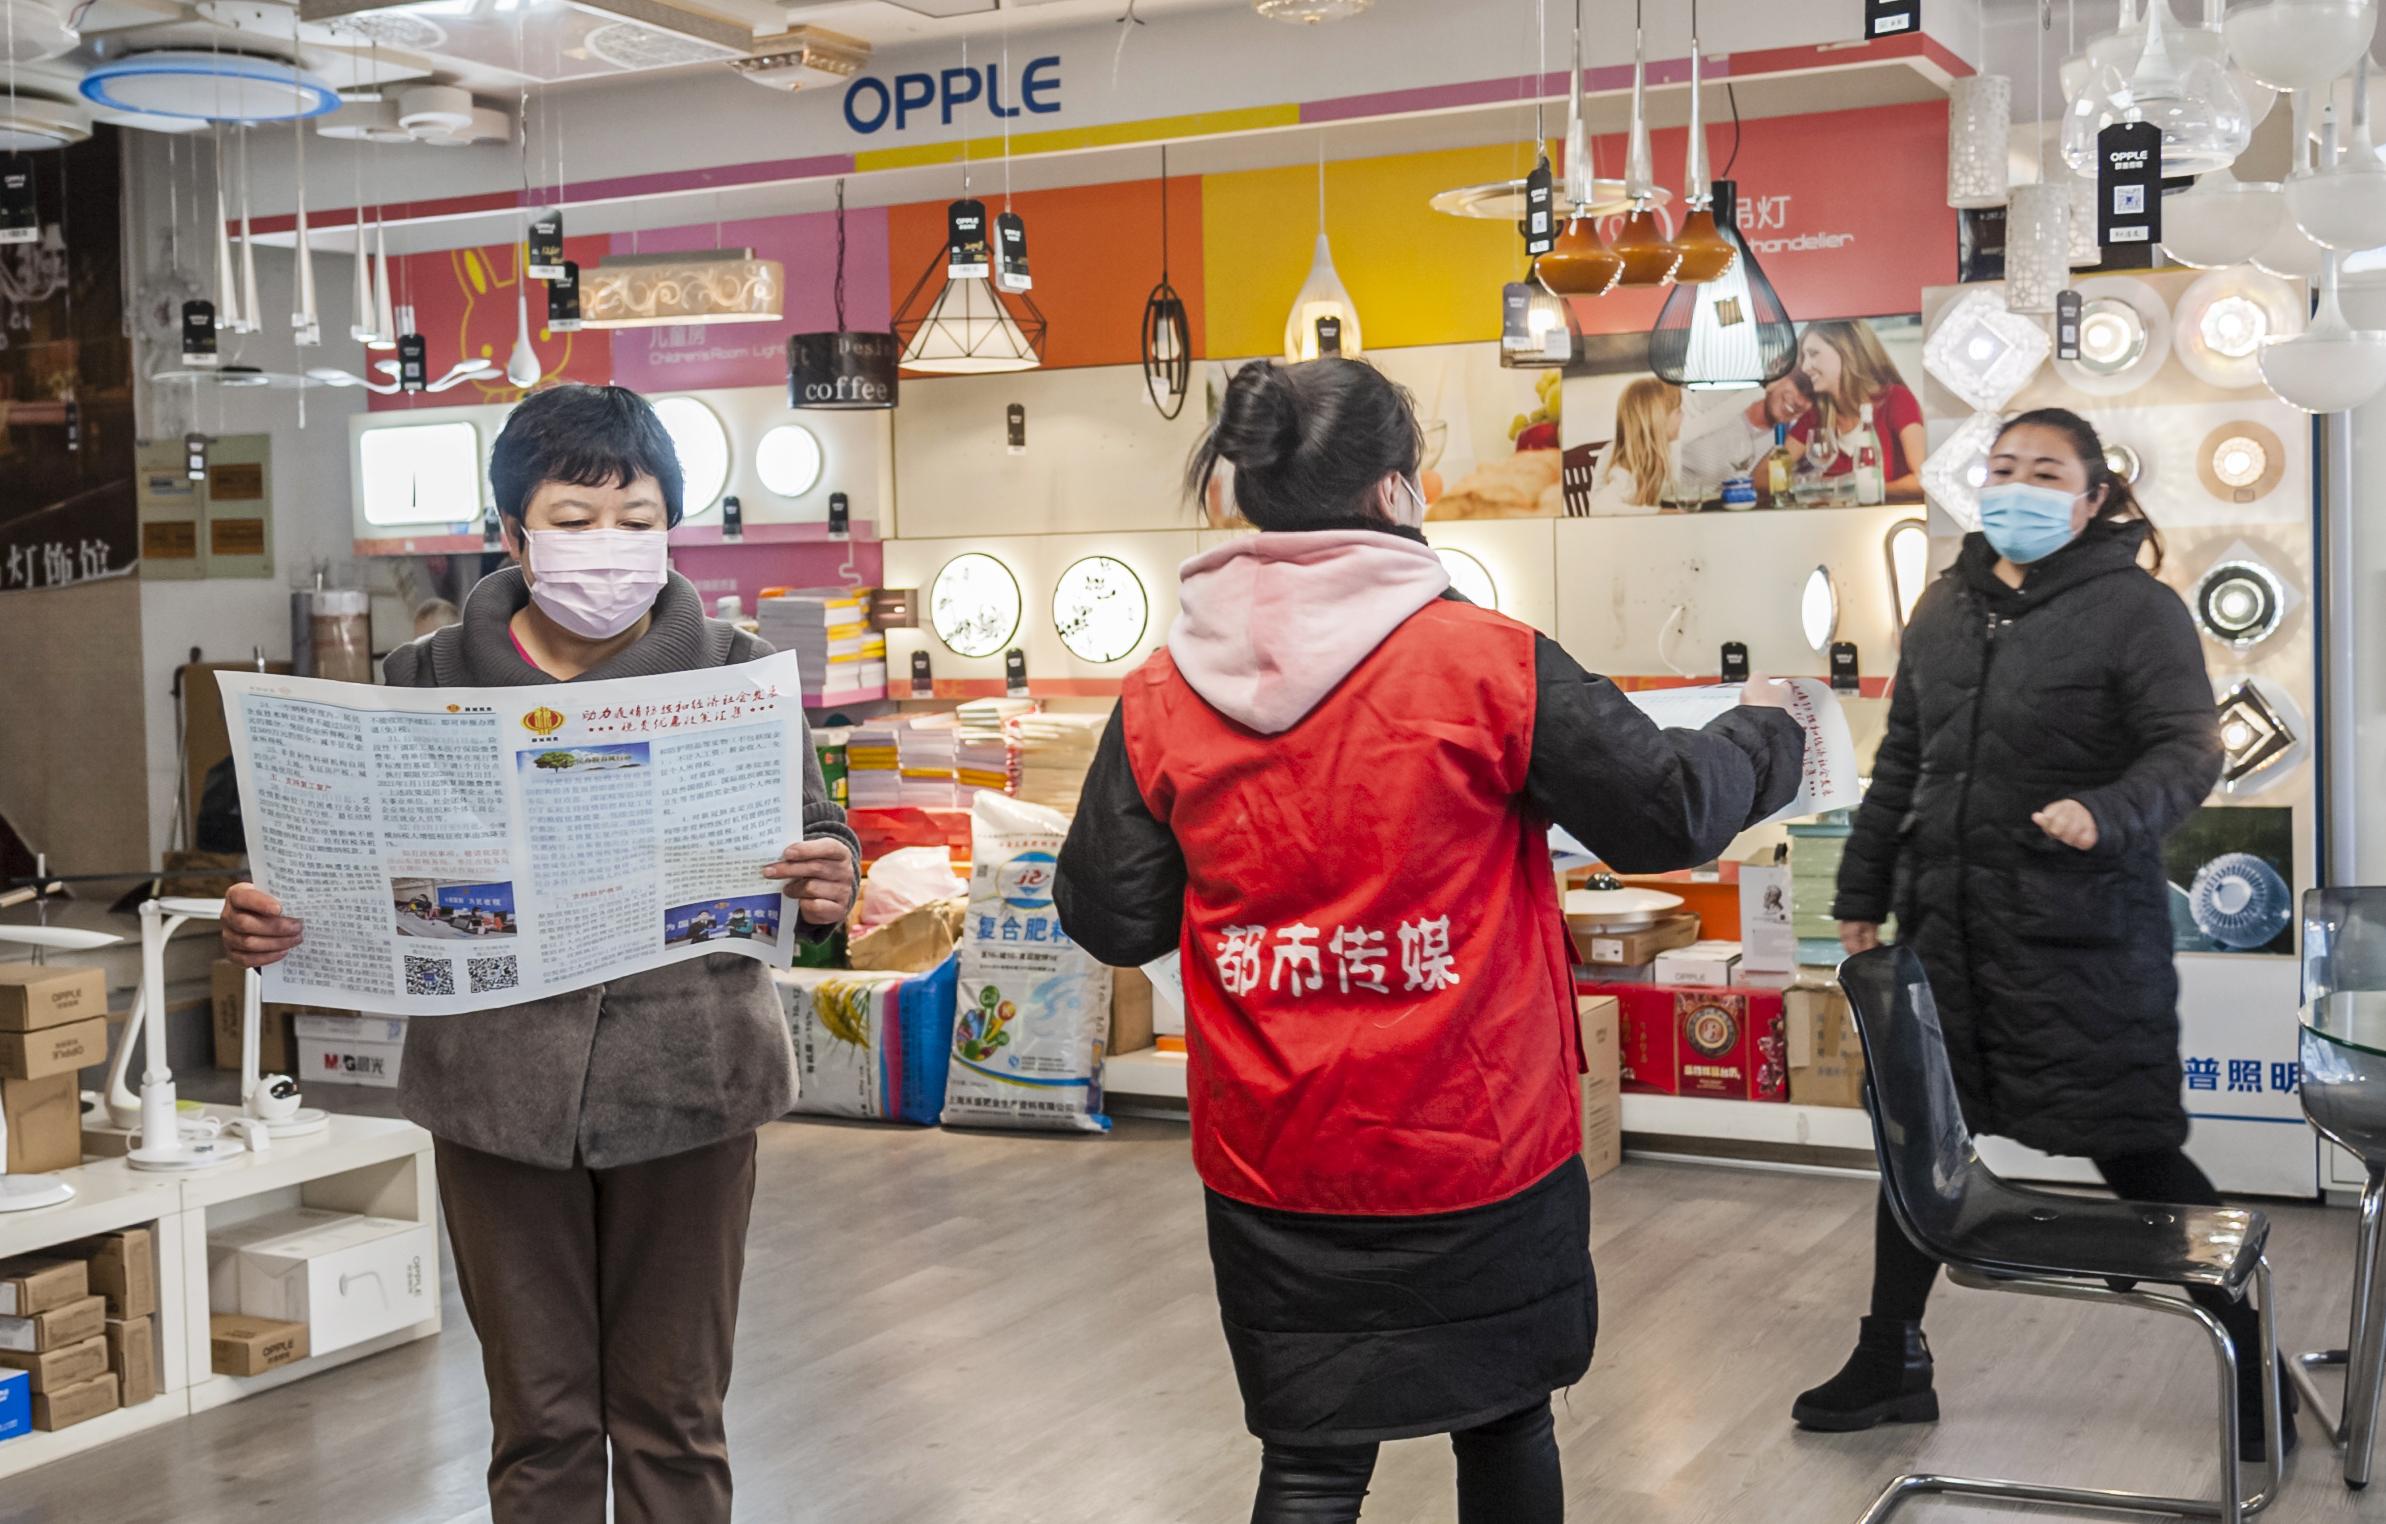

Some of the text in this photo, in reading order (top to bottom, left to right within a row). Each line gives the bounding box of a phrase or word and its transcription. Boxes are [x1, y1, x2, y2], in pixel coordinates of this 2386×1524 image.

[843, 56, 1061, 134] OPPLE
[2110, 150, 2148, 162] OPPLE
[1749, 233, 1855, 254] handelier
[804, 376, 888, 401] coffee
[1216, 914, 1461, 997] 都市传媒
